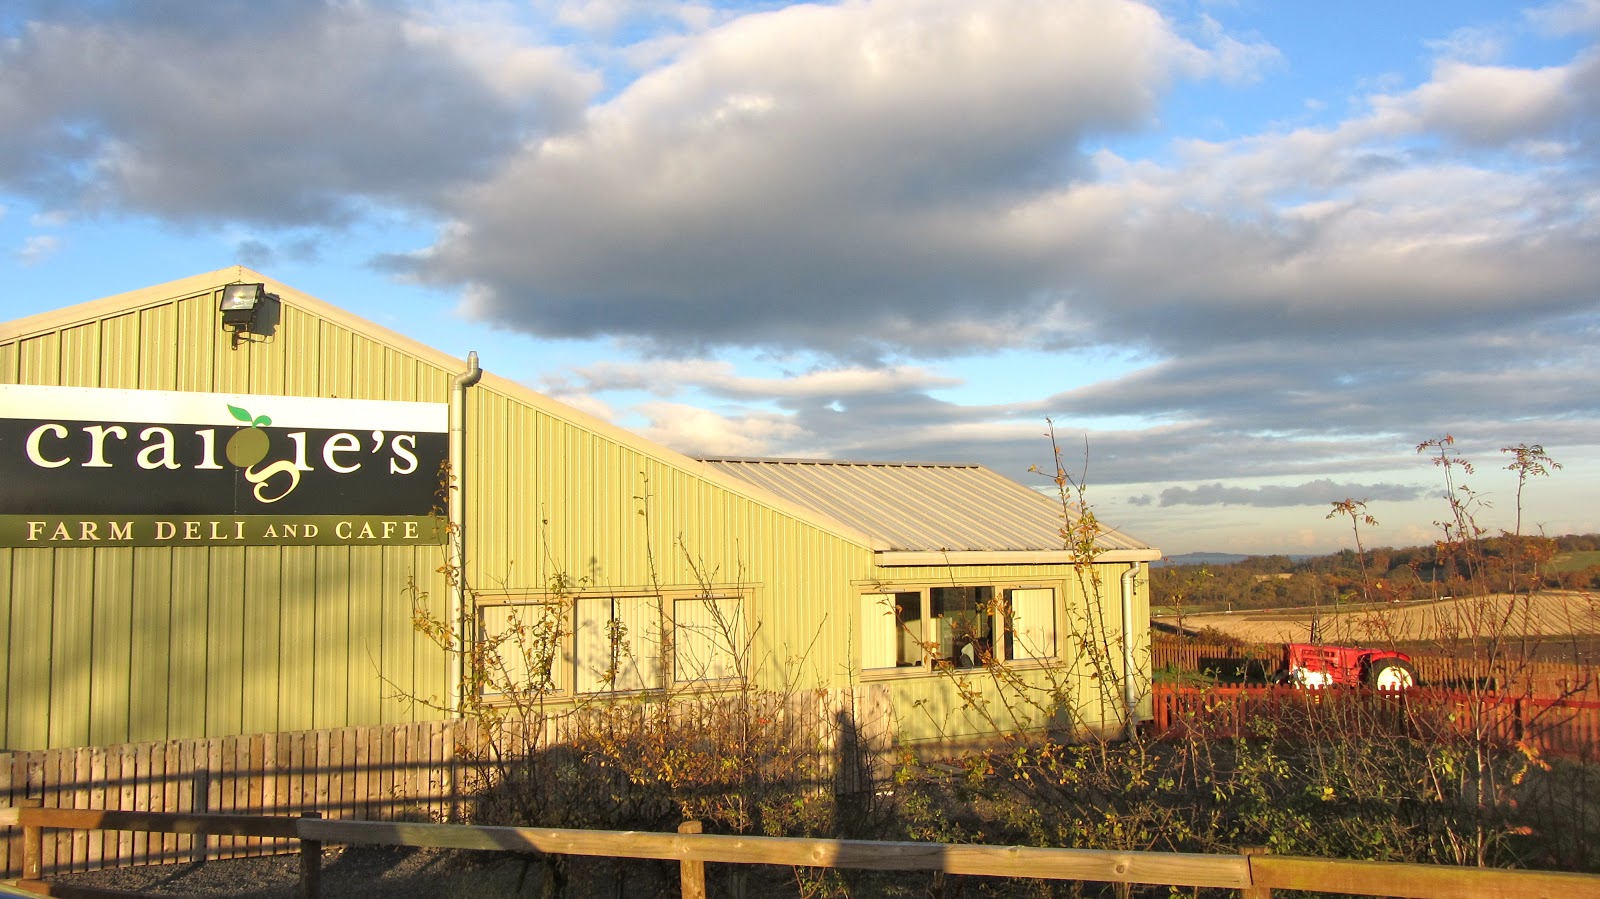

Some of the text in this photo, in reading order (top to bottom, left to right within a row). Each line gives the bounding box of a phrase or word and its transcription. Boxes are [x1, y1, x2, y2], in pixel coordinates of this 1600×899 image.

[25, 423, 419, 503] craigie's
[27, 520, 420, 541] FARM DELI AND CAFE
